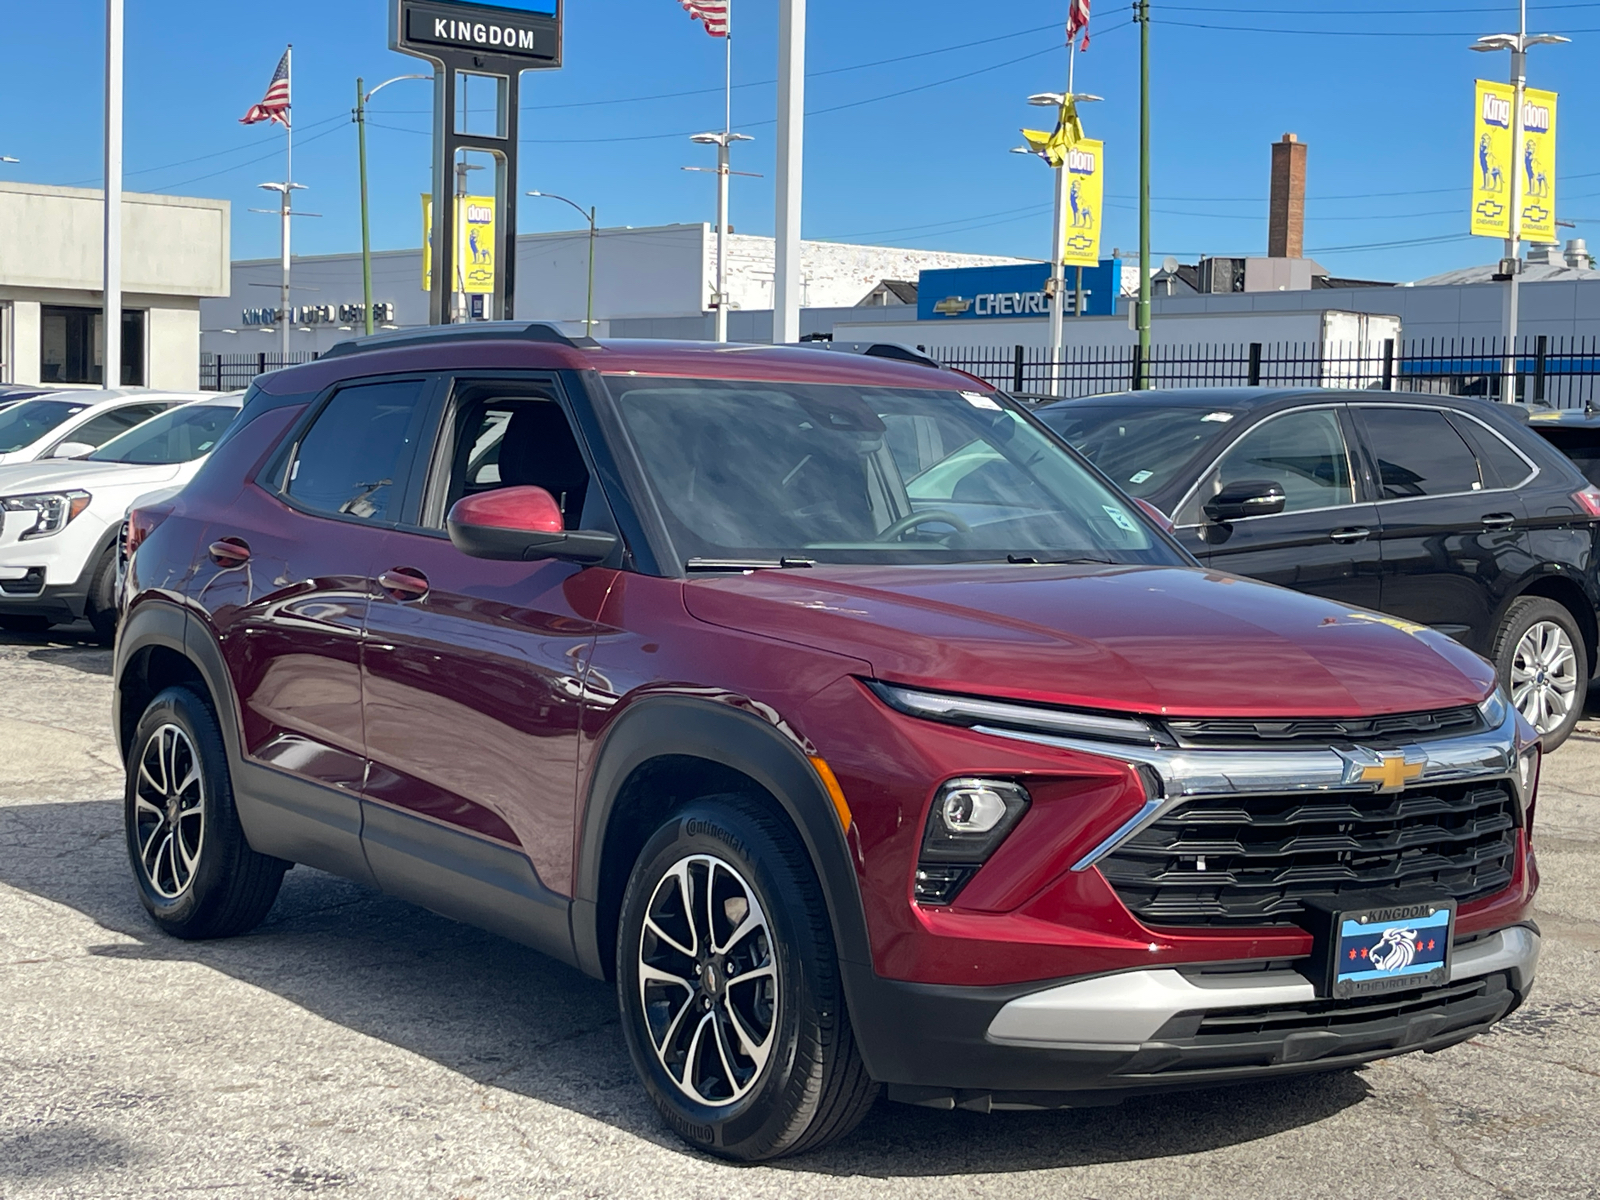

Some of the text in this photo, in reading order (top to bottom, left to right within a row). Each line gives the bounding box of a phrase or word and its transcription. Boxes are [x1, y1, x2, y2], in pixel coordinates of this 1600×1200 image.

[434, 18, 534, 50] KINGDOM
[1482, 92, 1511, 129] King
[1523, 100, 1549, 132] dom
[1069, 148, 1095, 174] dom
[468, 203, 492, 223] dom
[242, 302, 395, 325] KINGDM AUTO CENER
[975, 289, 1092, 315] CHEVROET
[686, 817, 745, 852] Continental
[1368, 904, 1429, 920] KINGDOM
[1361, 977, 1422, 992] CHEVROLET
